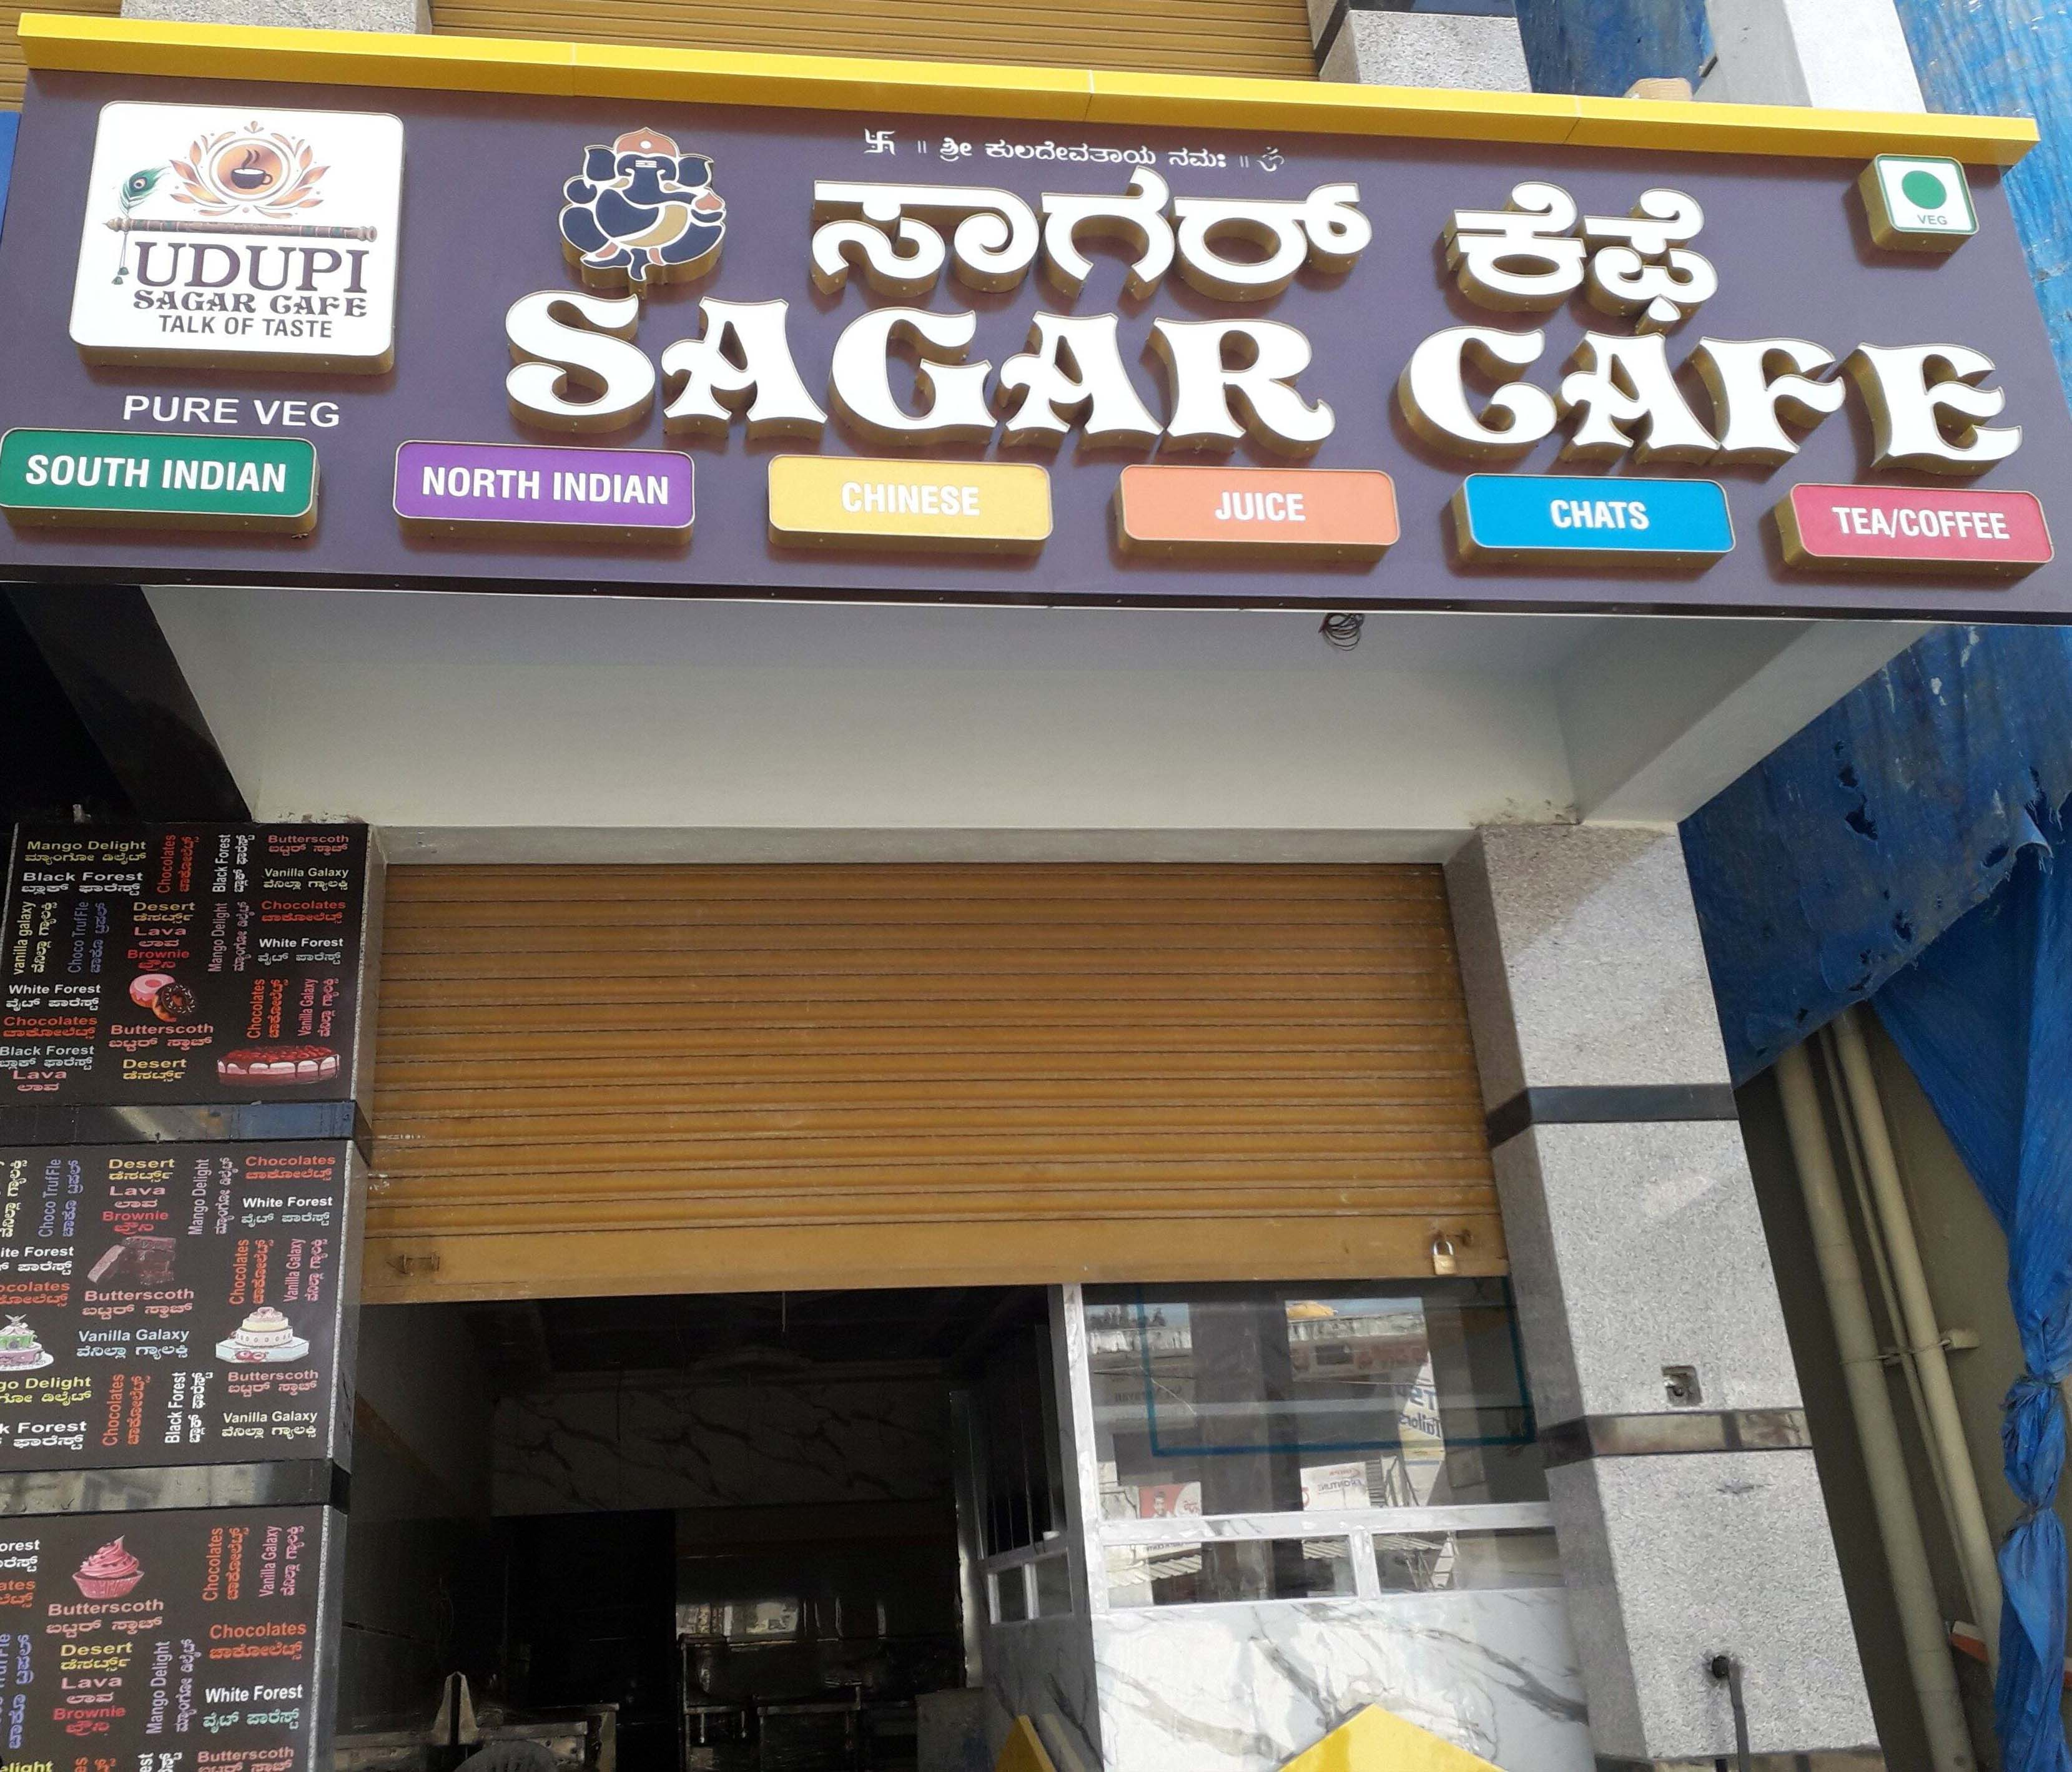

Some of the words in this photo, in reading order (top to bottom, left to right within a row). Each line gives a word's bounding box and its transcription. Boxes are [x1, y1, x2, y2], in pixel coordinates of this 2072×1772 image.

[939, 137, 972, 162] ಶ್ರೀ
[985, 139, 1156, 164] ಕುಲದೇವತಾಯ
[1168, 147, 1226, 167] ನಮಃ
[1917, 214, 1948, 225] VEG
[813, 166, 1374, 287] ಸಾಗರ್
[1450, 181, 1719, 325] ಕೆಫೆ
[134, 241, 370, 294] UDUPI
[132, 289, 257, 313] SAGAR
[269, 295, 368, 318] CAFE
[159, 315, 215, 334] TALK
[224, 317, 254, 335] OF
[262, 318, 332, 338] TASTE
[505, 290, 1337, 450] SAGAR
[1406, 325, 2023, 470] CAFE
[123, 395, 240, 425] PURE
[254, 398, 340, 427] VEG
[25, 454, 150, 488] SOUTH
[161, 459, 287, 493] INDIAN
[422, 465, 541, 501] NORTH
[551, 470, 669, 505] INDIAN
[841, 482, 981, 517] CHINESE
[1215, 491, 1306, 522] JUICE
[1549, 499, 1649, 530] CHATS
[1832, 506, 2010, 540] TEA/COFFEE
[27, 841, 82, 853] Mango
[88, 840, 147, 853] Delight
[215, 834, 231, 864] Forest
[267, 835, 350, 844] Butterscoth
[157, 834, 176, 893] Chocolates
[264, 868, 304, 877] Vanilla
[308, 867, 349, 879] Galaxy
[23, 872, 76, 882] Black
[82, 872, 144, 882] Forest
[212, 864, 228, 893] Black
[134, 902, 195, 911] Desert
[261, 900, 346, 910] Chocolates
[17, 901, 36, 937] galaxy
[211, 903, 230, 937] Delight
[134, 927, 187, 936] Lava
[259, 938, 297, 948] White
[301, 937, 343, 947] Forest
[13, 939, 28, 975] vanilla
[67, 940, 84, 973] Choco
[127, 950, 190, 959] Brownie
[208, 940, 227, 972] Mango
[9, 985, 50, 994] White
[54, 984, 101, 994] Forest
[300, 978, 318, 1007] Galaxy
[247, 978, 265, 1039] Chocolates
[3, 1016, 98, 1026] Chocolates
[111, 1023, 214, 1035] Butterscoth
[298, 1008, 313, 1037] Vanilla
[0, 1046, 41, 1056] Black
[46, 1045, 95, 1055] Forest
[12, 1070, 67, 1080] Lava
[123, 1058, 187, 1069] Desert
[109, 1158, 175, 1169] Desert
[245, 1155, 336, 1167] Chocolates
[192, 1159, 212, 1197] Delight
[110, 1186, 165, 1196] Lava
[243, 1198, 284, 1209] White
[288, 1196, 333, 1207] Forest
[37, 1201, 57, 1238] Choco
[103, 1211, 169, 1221] Brownie
[187, 1198, 209, 1236] Mango
[0, 1247, 19, 1258] ite
[24, 1246, 74, 1257] Forest
[286, 1238, 306, 1269] Galaxy
[229, 1239, 250, 1305] Chocolates
[0, 1281, 71, 1292] ocolates
[85, 1288, 194, 1302] Butterscoth
[283, 1270, 300, 1302] Vanilla
[79, 1330, 131, 1342] Vanilla
[136, 1328, 190, 1342] Galaxy
[25, 1376, 92, 1391] Delight
[228, 1369, 318, 1382] Butterscoth
[168, 1372, 186, 1409] Forest
[102, 1374, 125, 1447] Chocolates
[223, 1411, 267, 1424] Vanilla
[272, 1410, 318, 1423] Galaxy
[17, 1420, 87, 1434] Forest
[165, 1409, 183, 1444] Black
[0, 1539, 40, 1552] orest
[261, 1525, 282, 1561] Galaxy
[202, 1528, 223, 1602] Chocolates
[259, 1562, 276, 1598] Vanilla
[48, 1598, 164, 1617] Butterscoth
[210, 1622, 307, 1639] Chocolates
[61, 1641, 133, 1656] Desert
[150, 1640, 173, 1687] Delight
[61, 1676, 123, 1690] Lava
[205, 1687, 249, 1703] White
[254, 1684, 303, 1701] Forest
[53, 1705, 126, 1721] Brownie
[146, 1690, 169, 1735] Mango
[198, 1746, 295, 1763] Butterscoth
